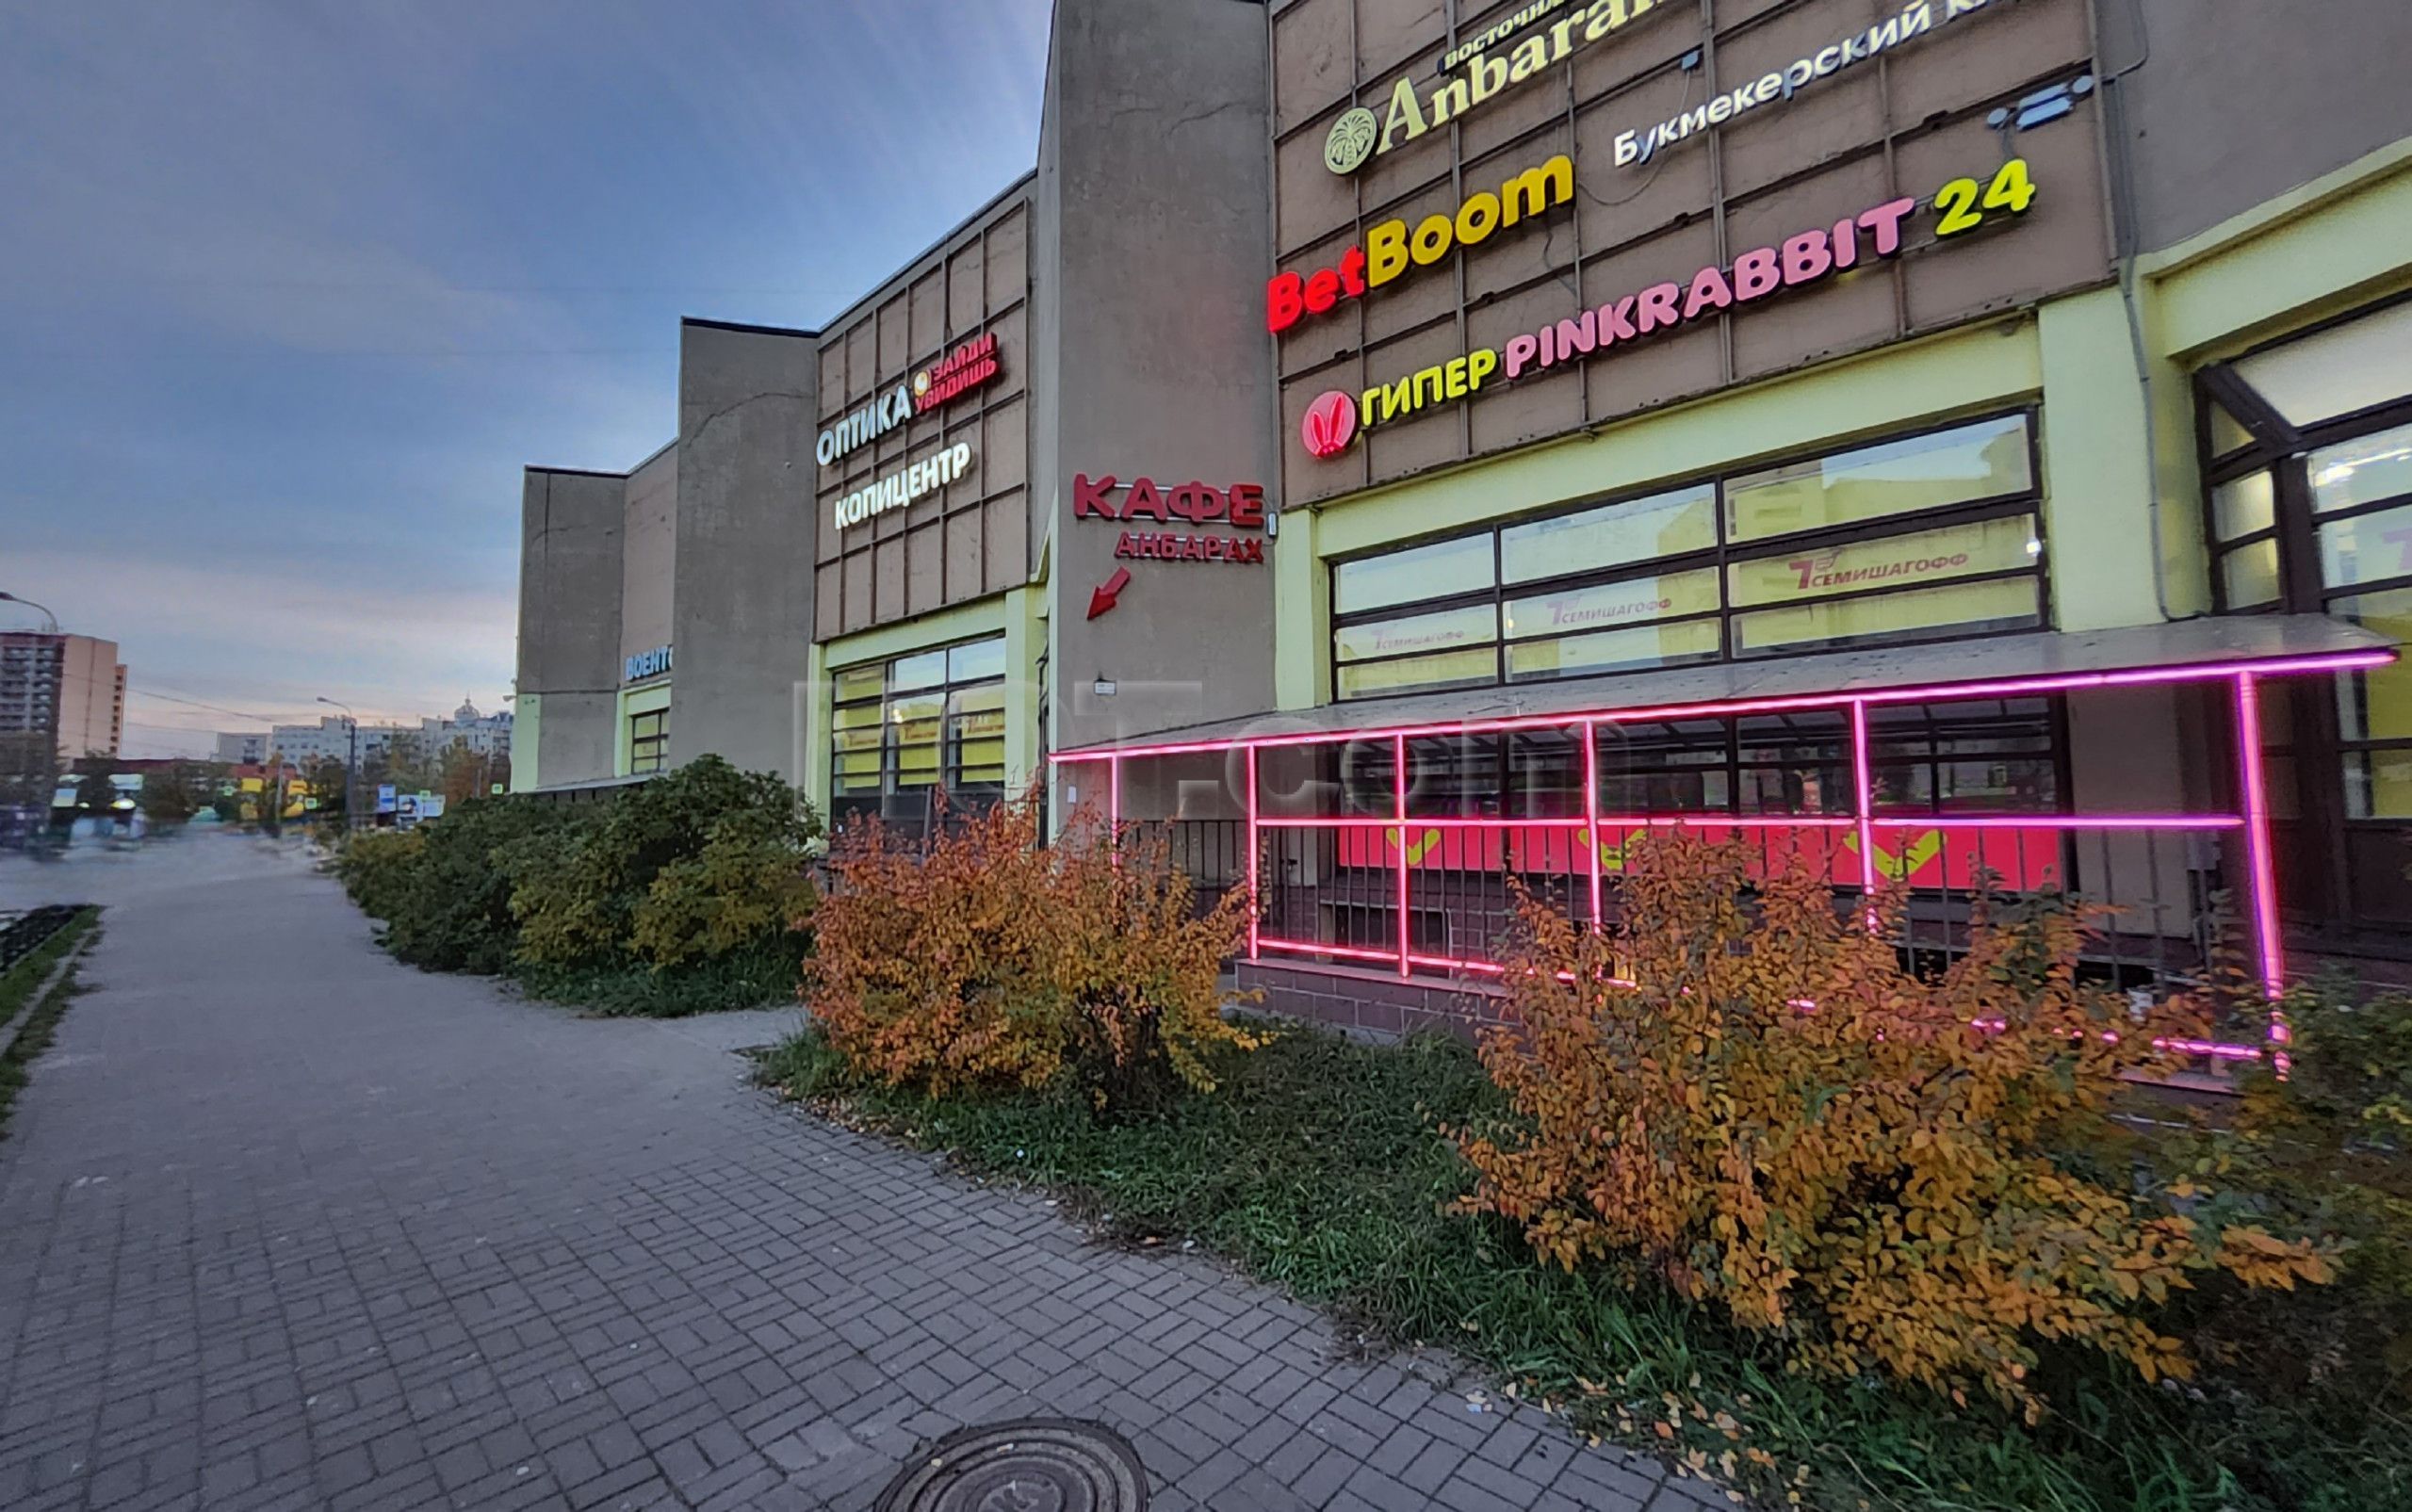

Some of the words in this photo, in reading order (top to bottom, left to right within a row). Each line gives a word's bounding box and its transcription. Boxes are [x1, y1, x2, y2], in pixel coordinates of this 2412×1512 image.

[1376, 0, 1663, 155] Anbara
[1614, 0, 1931, 167] Букмекерский
[1267, 154, 1573, 333] BetBoom
[1362, 349, 1496, 426] ГИПЕР
[1506, 196, 1915, 378] PINKRABBIT
[1934, 158, 2036, 236] 24
[915, 360, 998, 415] УВИДИШЬ
[931, 332, 993, 382] ЗАЙДИ
[816, 384, 912, 466] ОПТИКА
[835, 442, 971, 529] КОПИЦЕНТР
[1073, 473, 1264, 527] КАФЕ
[1115, 531, 1264, 563] АНБАРАХ
